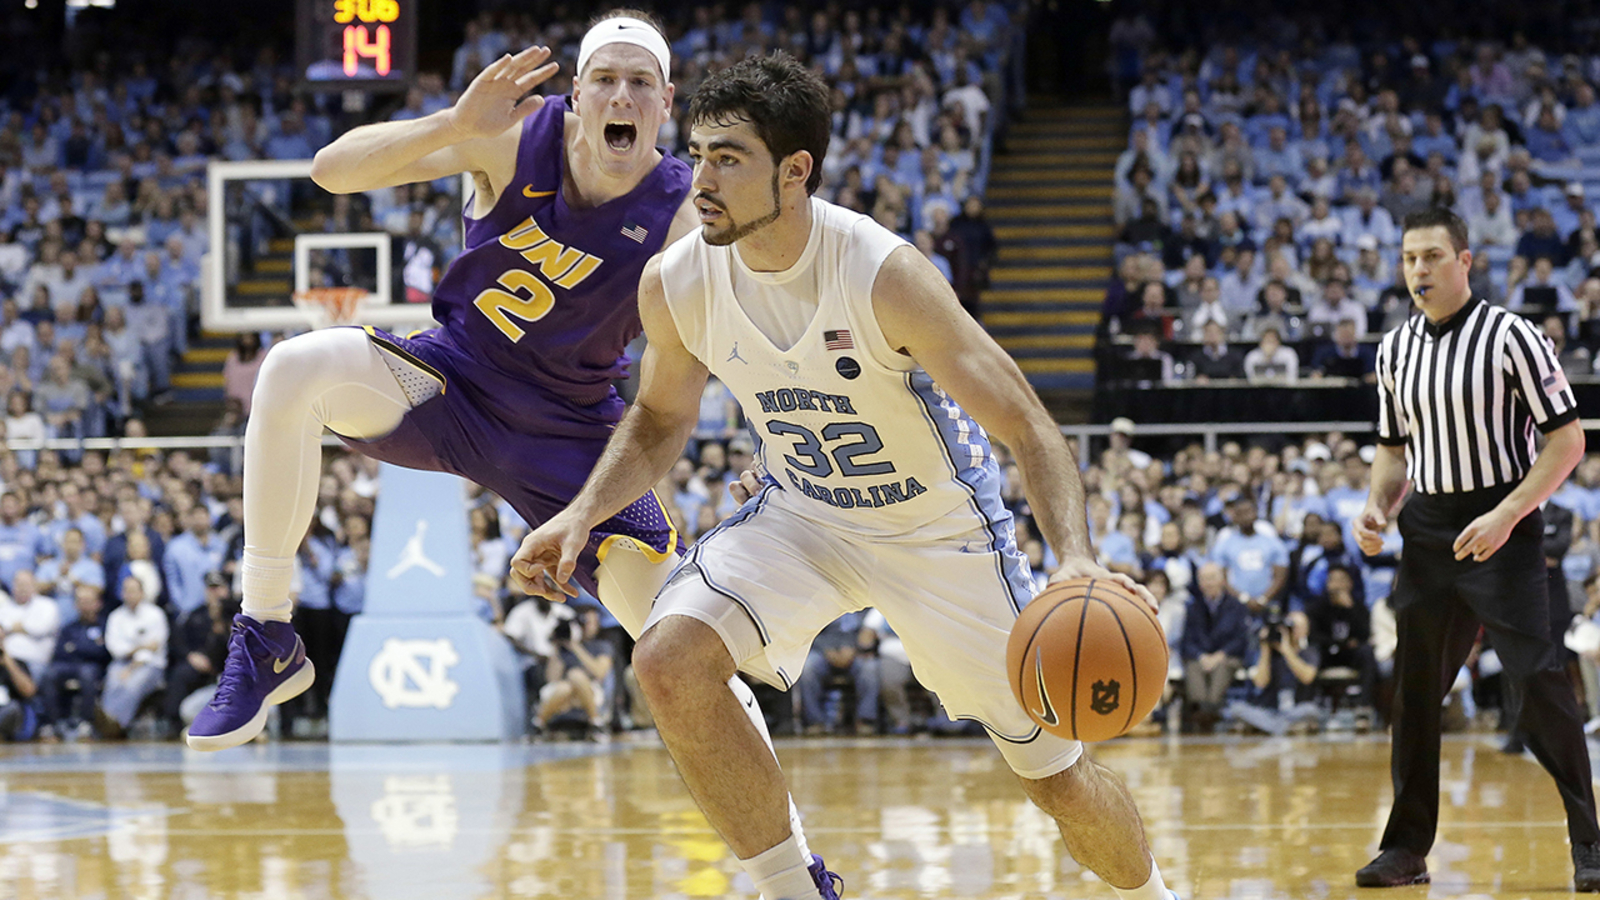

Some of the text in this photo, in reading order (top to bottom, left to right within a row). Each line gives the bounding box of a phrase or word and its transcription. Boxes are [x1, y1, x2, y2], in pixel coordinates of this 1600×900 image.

[343, 25, 391, 76] 14
[499, 215, 604, 290] UNI
[473, 269, 556, 343] 2
[755, 388, 858, 415] NORTH
[766, 419, 897, 478] 32
[785, 467, 928, 509] CAROLINA
